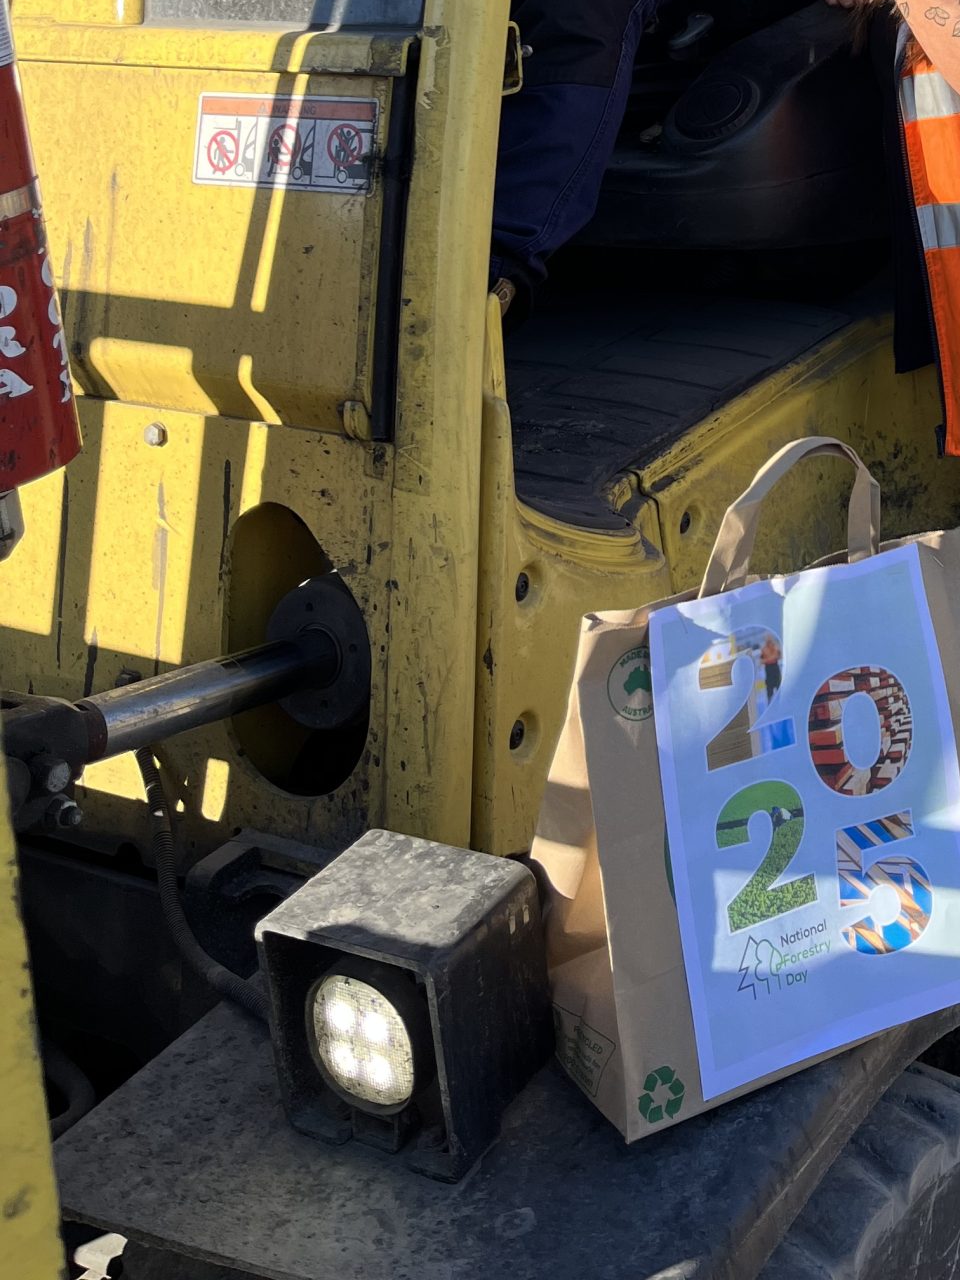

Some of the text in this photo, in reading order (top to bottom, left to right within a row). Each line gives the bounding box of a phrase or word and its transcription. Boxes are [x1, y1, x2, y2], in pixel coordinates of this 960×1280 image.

[274, 104, 316, 116] WANG
[780, 919, 827, 947] National
[782, 939, 831, 967] Forestry
[786, 969, 808, 986] Day
